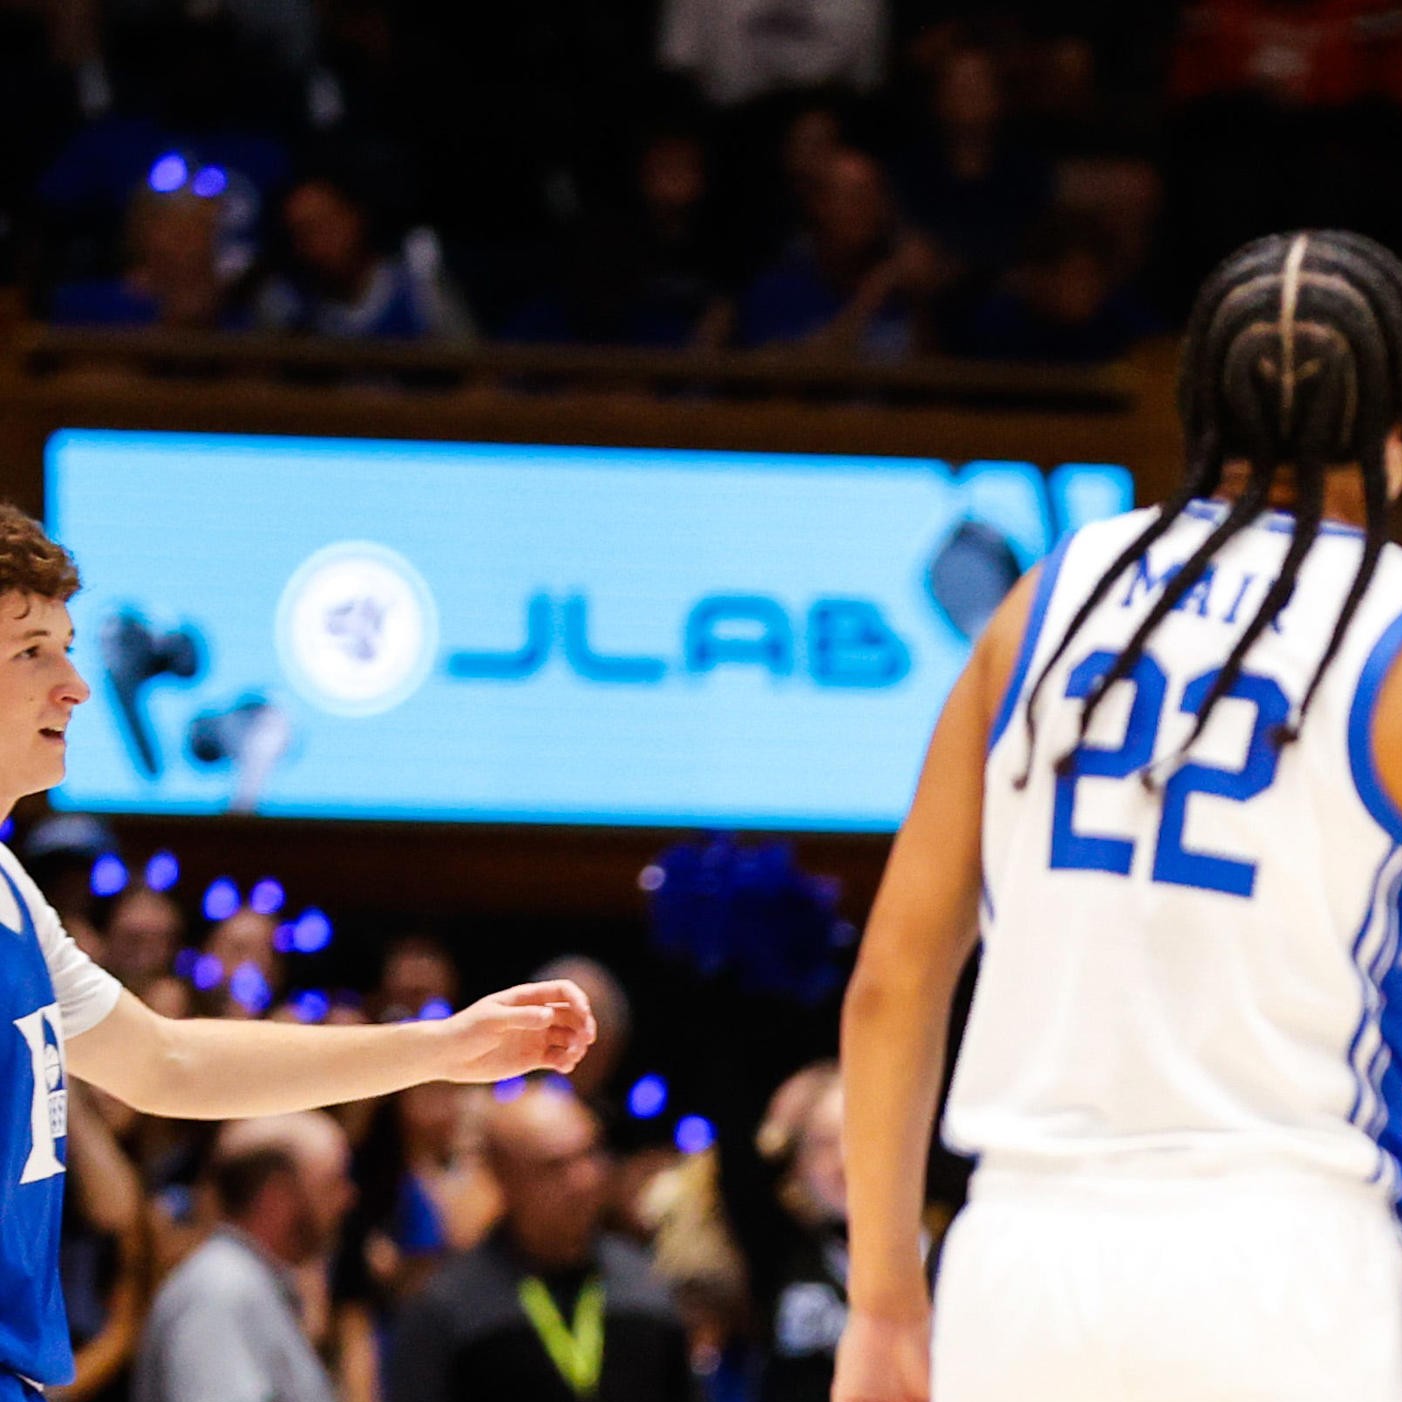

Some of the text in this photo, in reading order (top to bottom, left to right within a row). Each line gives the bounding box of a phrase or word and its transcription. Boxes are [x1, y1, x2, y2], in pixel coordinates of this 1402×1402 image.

[447, 592, 911, 690] JLAB
[1120, 550, 1284, 634] MAI
[1048, 648, 1292, 899] 22
